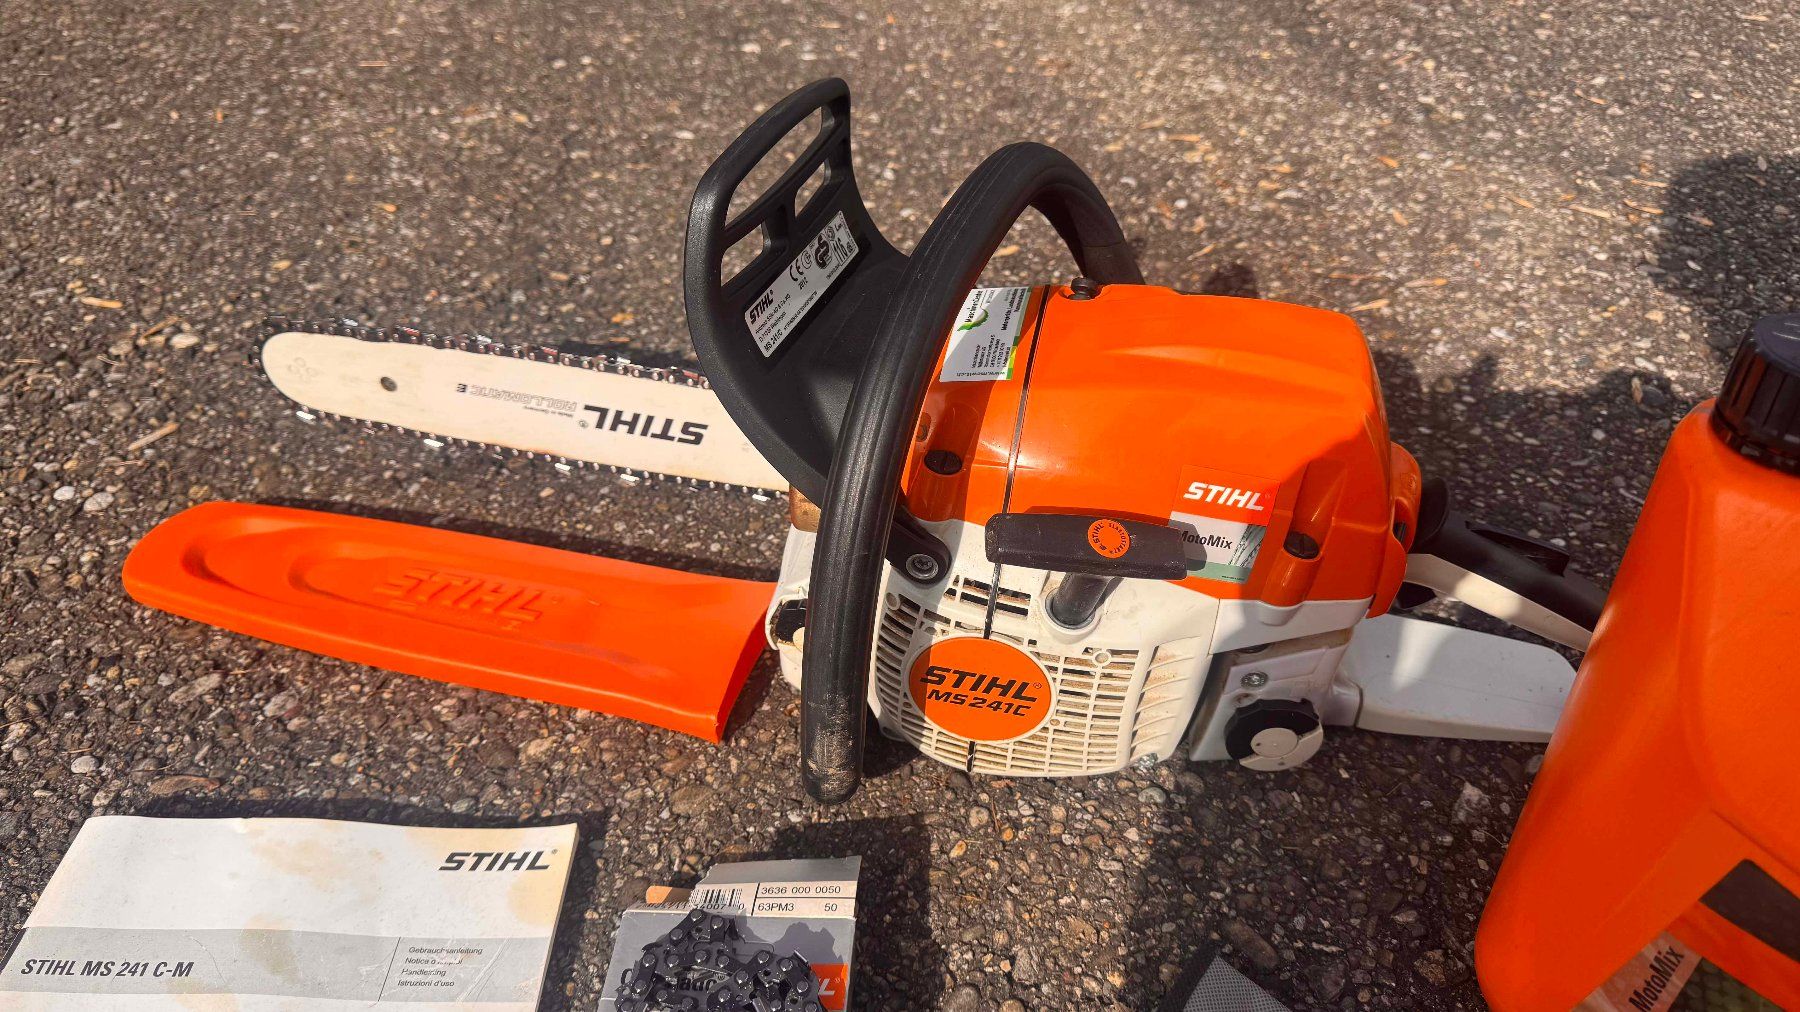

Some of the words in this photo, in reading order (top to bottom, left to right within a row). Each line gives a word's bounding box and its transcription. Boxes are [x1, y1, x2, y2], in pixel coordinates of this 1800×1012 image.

[750, 296, 774, 324] STIHL
[456, 383, 467, 393] E
[470, 384, 577, 412] ROLLOMATIC
[584, 404, 709, 446] STIHL
[1183, 482, 1264, 511] STIHL
[373, 566, 544, 622] STIHL
[920, 665, 1038, 703] STIHL
[438, 852, 552, 872] STIHL
[761, 886, 788, 894] 3636
[791, 886, 811, 894] 000
[815, 886, 841, 894] 0050
[758, 902, 795, 912] 63PM3
[824, 902, 838, 912] 50
[20, 958, 78, 977] STIHL
[80, 959, 115, 978] MS
[114, 960, 150, 978] 241
[152, 961, 196, 978] C-M
[1628, 946, 1684, 1012] MotoMix
